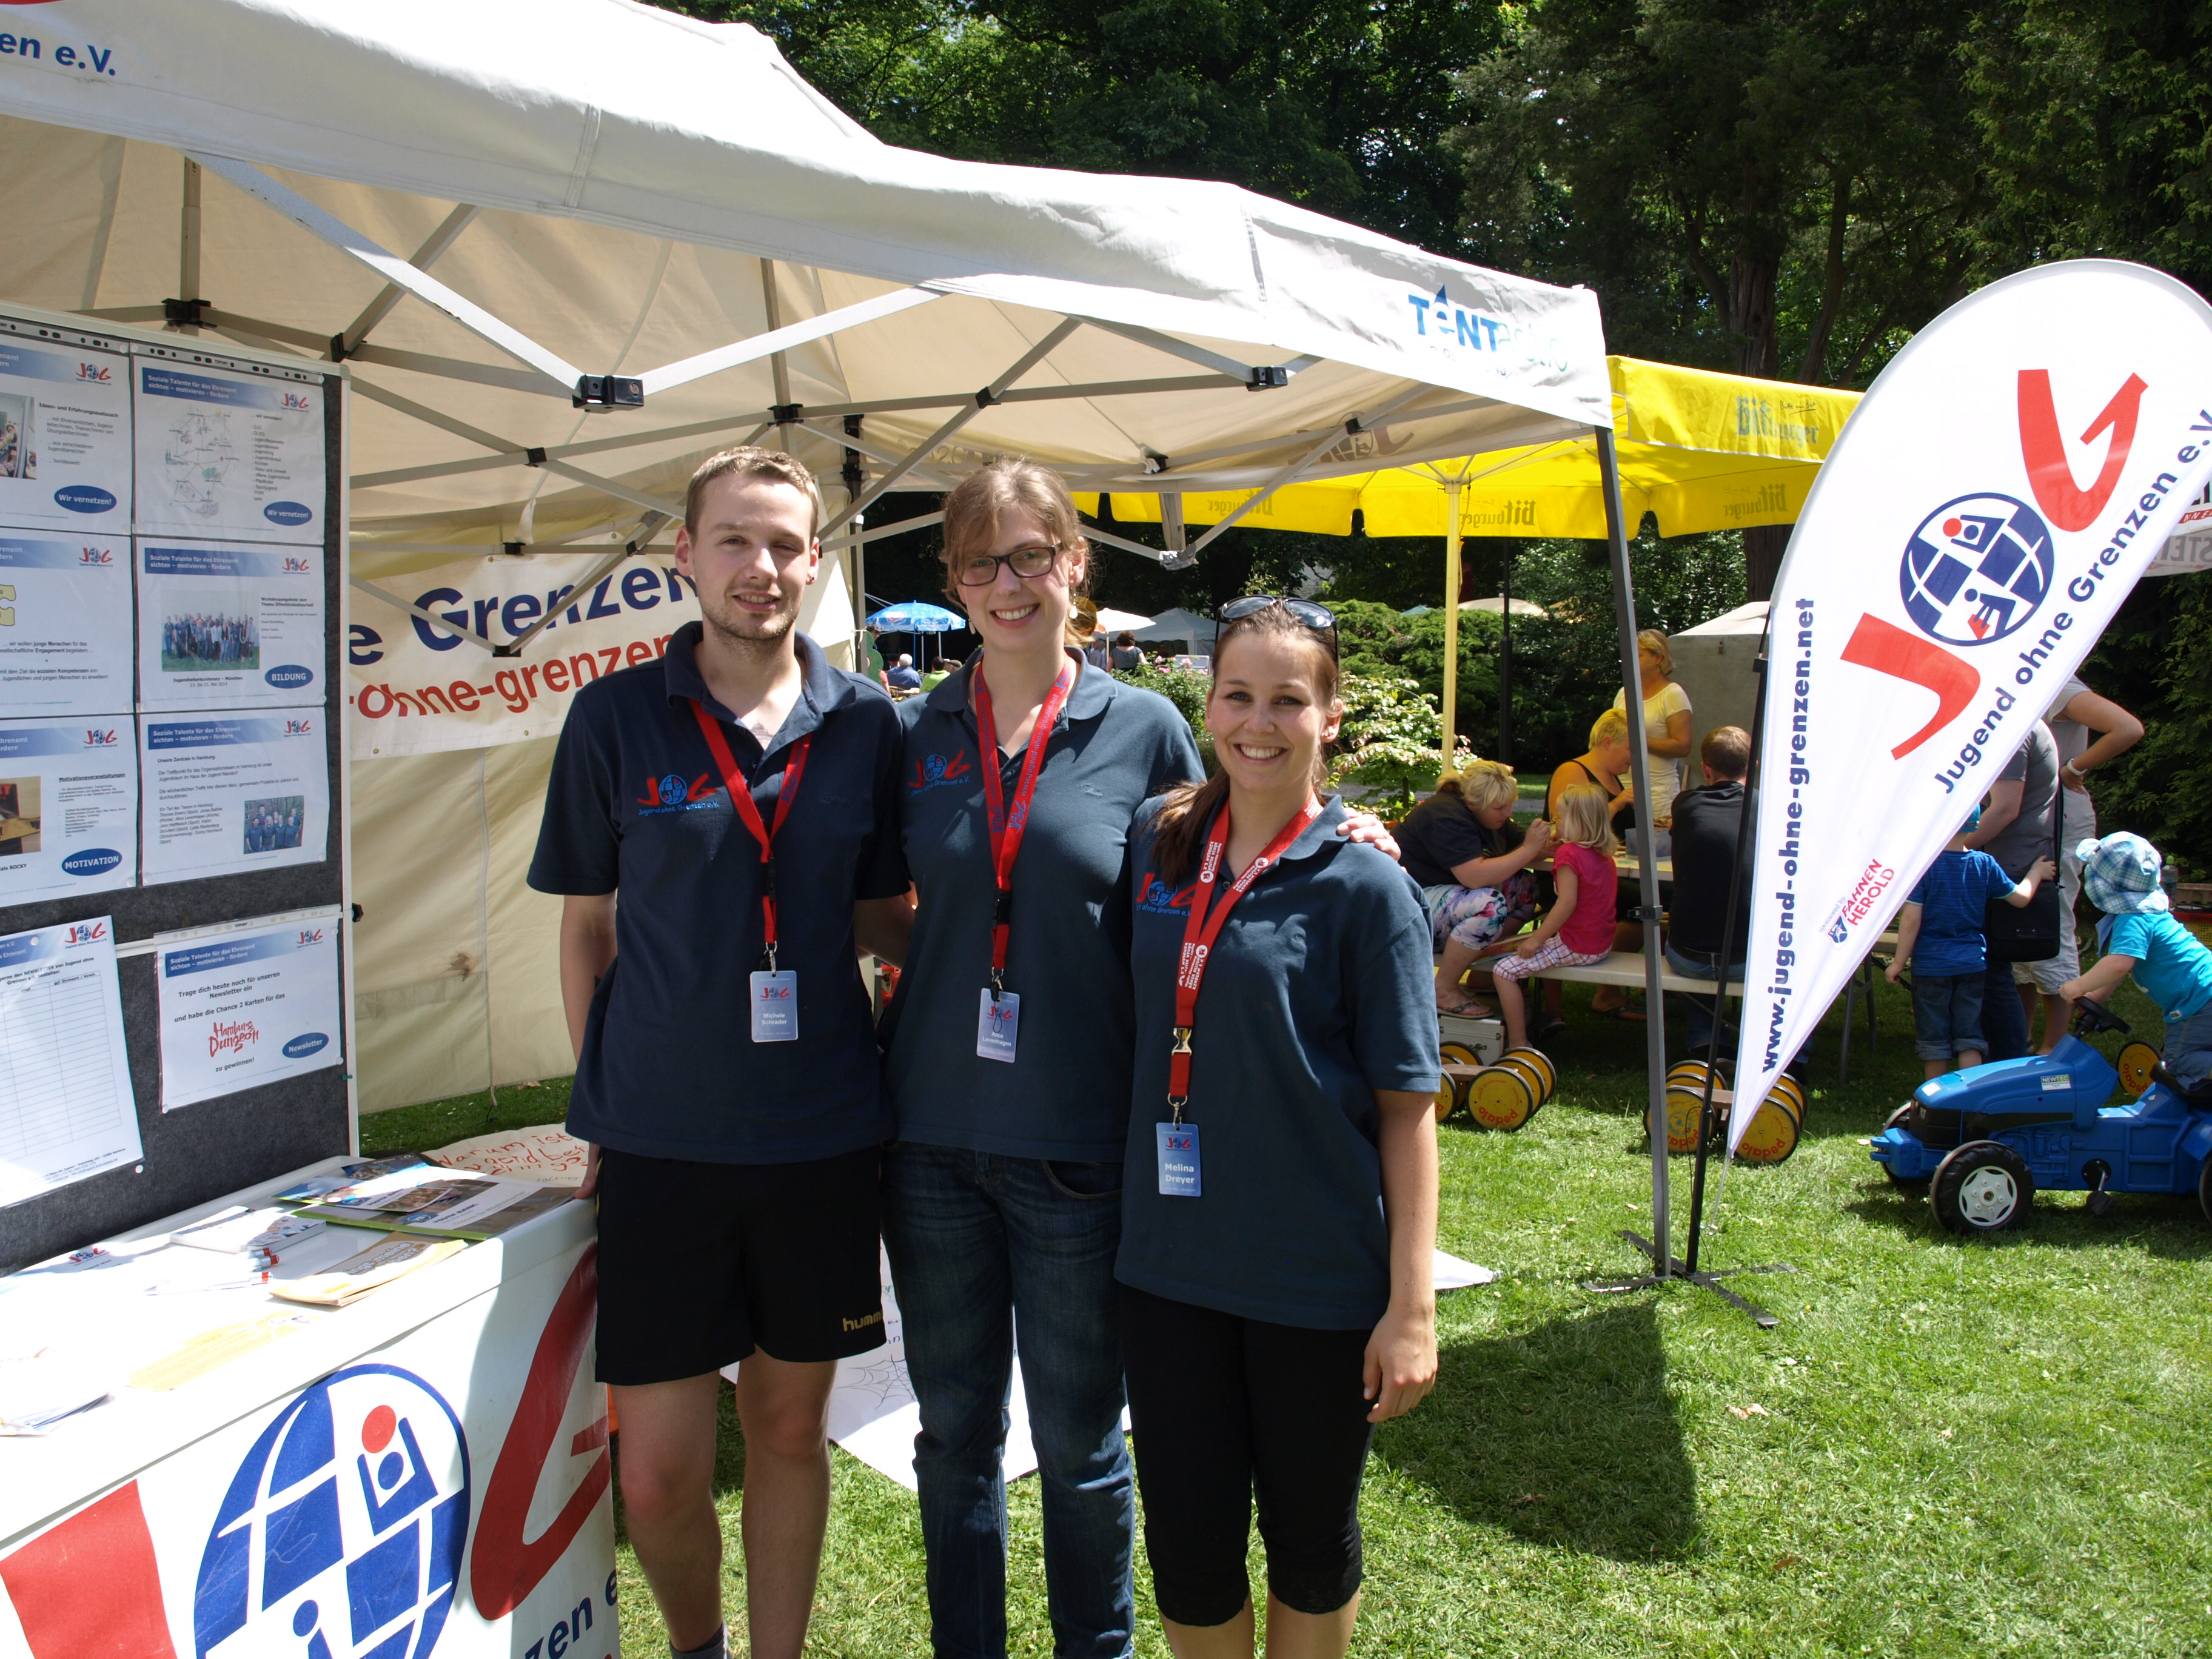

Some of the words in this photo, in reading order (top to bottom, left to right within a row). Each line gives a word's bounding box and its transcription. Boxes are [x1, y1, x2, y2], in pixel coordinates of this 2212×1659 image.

[55, 44, 116, 76] e.V.
[148, 375, 169, 383] Soziale
[170, 378, 190, 387] Talente
[74, 496, 112, 505] vernetzen!
[1934, 686, 2016, 794] Jugend
[2016, 613, 2073, 685] ohne
[2068, 473, 2177, 603] Grenzen
[272, 672, 306, 682] BILDUNG
[1762, 598, 1814, 1074] www.jugend-ohne-grenzen.net
[65, 856, 119, 870] MOTIVATION
[1842, 859, 1882, 917] FAHNEN
[1848, 869, 1894, 925] HEROLD
[170, 956, 190, 964] Soziale
[170, 962, 190, 971] sichten
[197, 956, 225, 967] motivieren
[178, 989, 196, 998] Trage
[213, 982, 230, 991] heute
[232, 978, 246, 987] noch
[257, 971, 280, 982] unseren
[209, 987, 242, 999] Newsletter
[188, 1011, 204, 1020] habe
[216, 1004, 238, 1013] Chance
[245, 997, 264, 1007] Karten
[289, 1039, 323, 1053] Newsletter
[224, 1057, 254, 1071] gewinnen!
[1479, 1107, 1518, 1125] pedalo
[1741, 1138, 1786, 1158] pedalo
[1165, 1163, 1194, 1172] Melina
[1165, 1175, 1195, 1184] Dreyer
